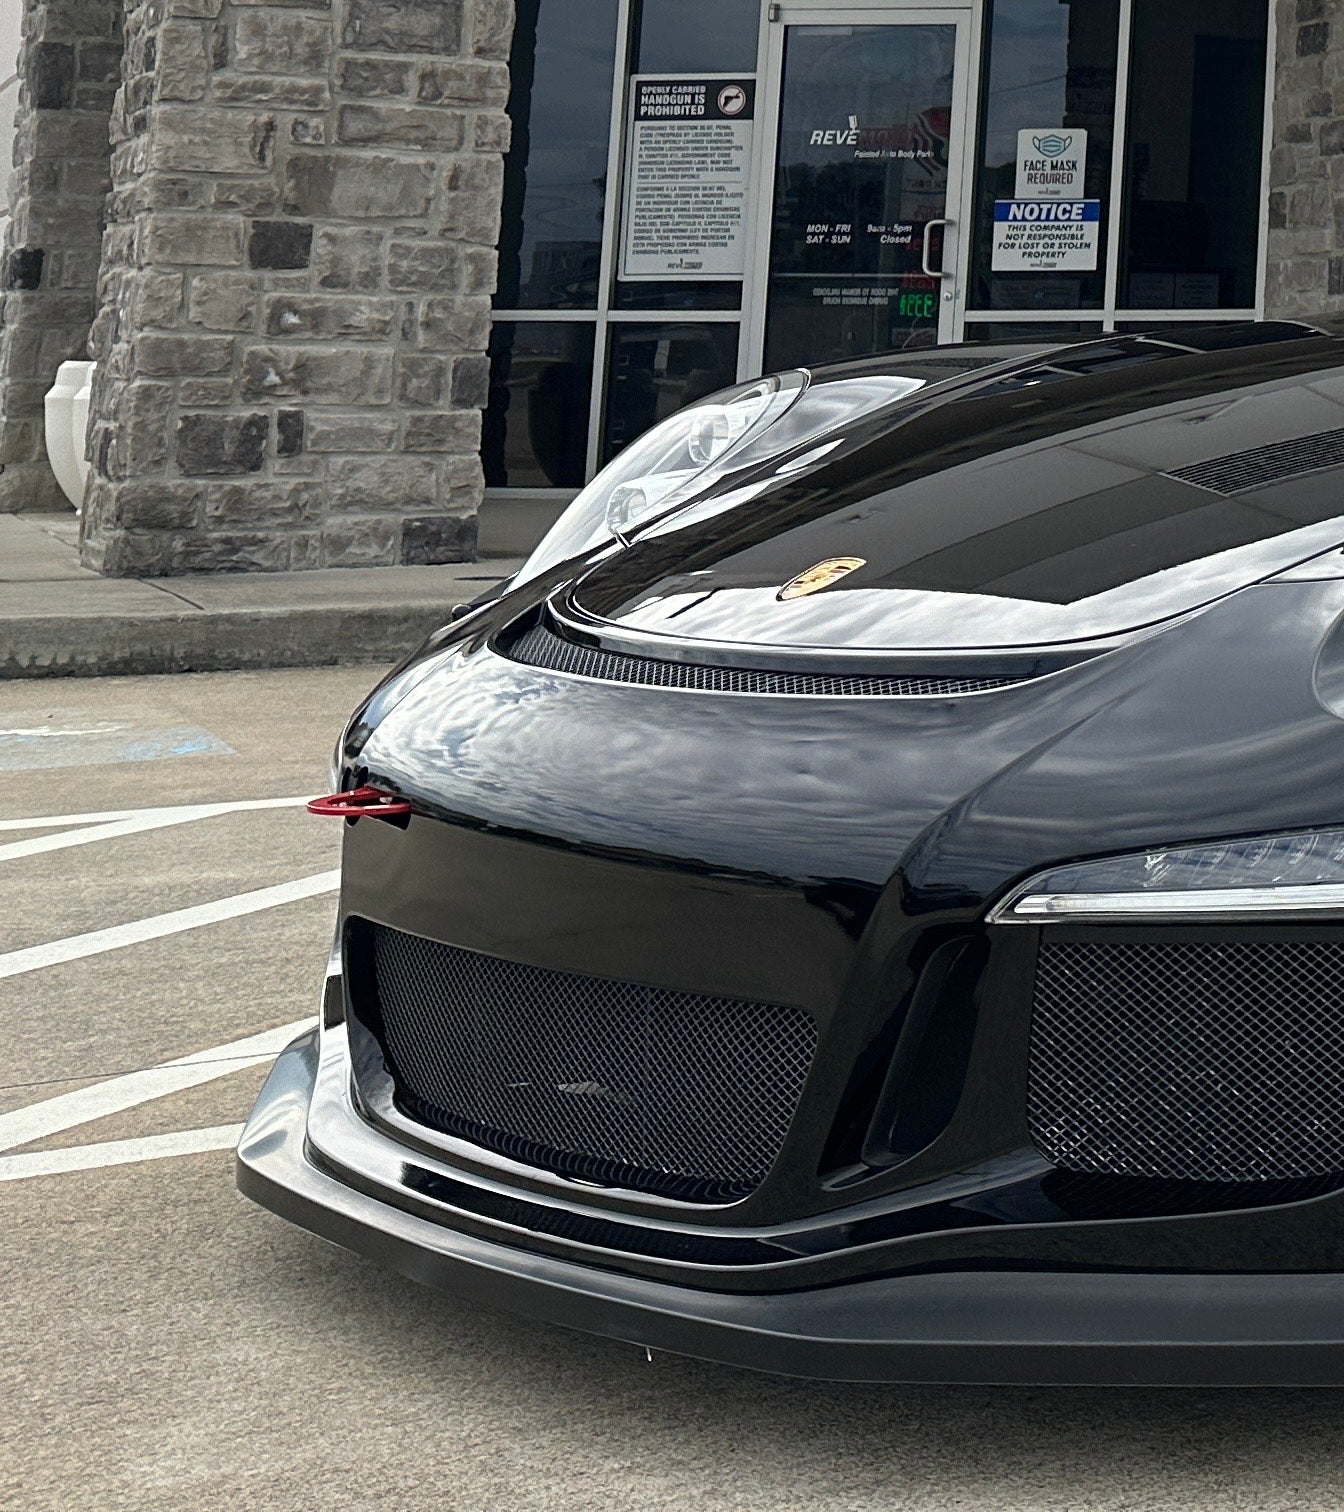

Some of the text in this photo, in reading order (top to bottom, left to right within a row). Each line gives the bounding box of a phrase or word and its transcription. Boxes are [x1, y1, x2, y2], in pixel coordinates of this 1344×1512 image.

[641, 86, 706, 94] OPENLY CARRIED
[641, 94, 705, 105] HANDGUN IS
[640, 105, 705, 116] PROHIBITED
[810, 130, 859, 145] REVE
[881, 149, 897, 158] Ato
[1024, 160, 1078, 172] FACE MASK
[1027, 173, 1073, 185] REQUIRED
[1008, 203, 1085, 220] NOTICE
[806, 224, 828, 233] MON
[835, 224, 851, 232] FRI
[893, 223, 913, 234] 5pm
[1007, 224, 1085, 232] THIS COMPANY IS
[806, 235, 824, 244] SAT
[830, 235, 851, 244] SUN
[880, 235, 912, 244] Closed
[1005, 233, 1085, 241] NOT RESPONSIBLE
[998, 242, 1091, 250] FOR LOST OR STOLEN
[1022, 251, 1067, 259] PROPERTY
